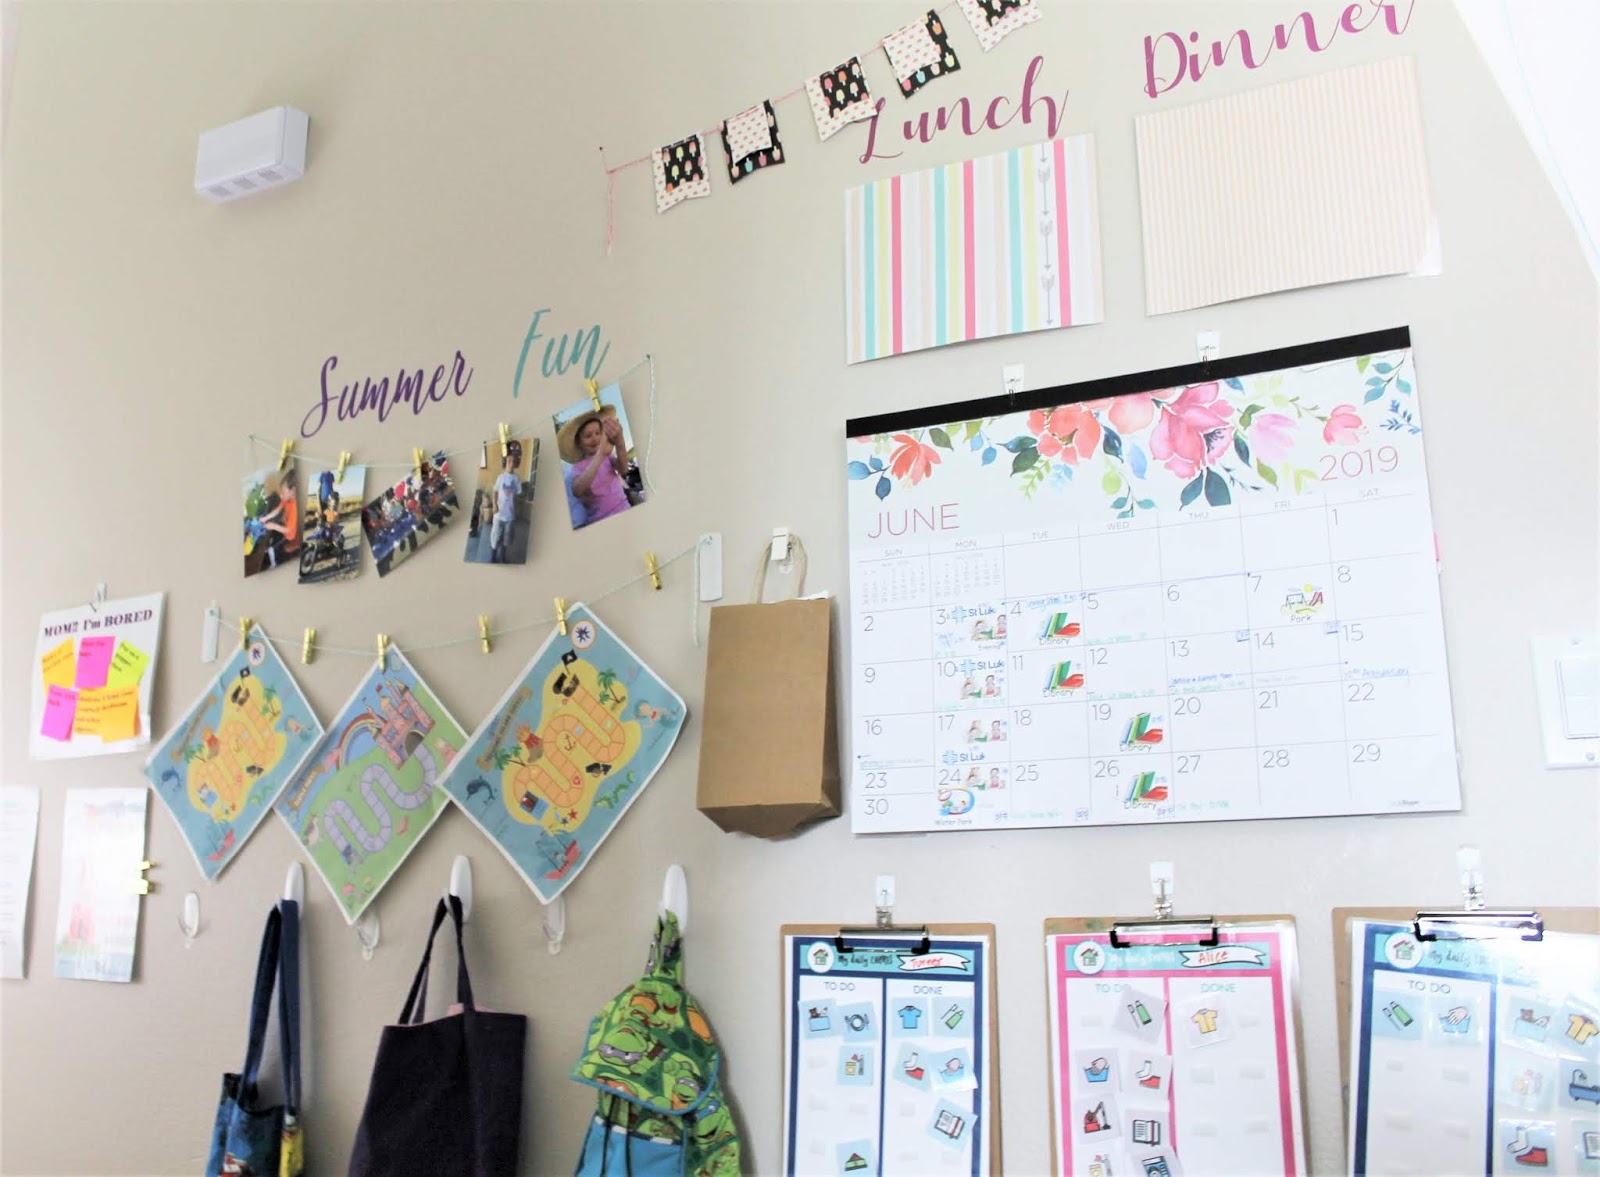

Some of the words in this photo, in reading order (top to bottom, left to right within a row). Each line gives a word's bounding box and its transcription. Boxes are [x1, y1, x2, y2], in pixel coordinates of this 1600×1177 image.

[1142, 0, 1414, 99] Dinner
[858, 55, 1069, 164] Lunch
[300, 350, 473, 438] Summer
[512, 308, 611, 399] Fun
[1319, 445, 1399, 482] 2019
[867, 502, 960, 539] JUNE
[884, 549, 903, 557] SUN
[955, 539, 978, 549] MON
[1032, 531, 1049, 540] TUE
[1106, 521, 1130, 531] WED
[1188, 512, 1209, 520] THU
[1274, 500, 1292, 509] FRI
[1361, 487, 1379, 498] SAT
[1332, 508, 1339, 526] 1
[863, 616, 875, 632] 2
[936, 608, 947, 625] 3
[1010, 601, 1022, 616] 4
[1087, 592, 1099, 611] 5
[1167, 584, 1180, 602] 6
[1251, 575, 1262, 593] 7
[1337, 565, 1352, 583] 8
[83, 619, 101, 631] I'm
[104, 609, 153, 627] BORED
[1291, 614, 1312, 623] Park
[1039, 638, 1070, 646] Library
[864, 667, 876, 684] 9
[937, 660, 958, 678] 10
[1012, 655, 1024, 671] 11
[1089, 647, 1108, 665] 12
[1170, 639, 1190, 657] 13
[1255, 632, 1276, 649] 14
[1342, 623, 1364, 641] 15
[1043, 690, 1075, 699] Library
[864, 719, 883, 736] 16
[938, 714, 955, 732] 17
[1014, 709, 1032, 726] 18
[1092, 703, 1112, 721] 19
[1174, 697, 1202, 716] 20
[1259, 690, 1279, 709] 21
[1348, 683, 1376, 702] 22
[1119, 744, 1152, 753] Library
[864, 773, 887, 789] 23
[938, 768, 961, 786] 24
[1015, 764, 1039, 782] 25
[1095, 759, 1120, 778] 26
[1177, 755, 1201, 774] 27
[1262, 749, 1291, 769] 28
[1352, 743, 1382, 763] 29
[864, 798, 889, 816] 30
[1124, 801, 1157, 810] Library
[1197, 951, 1229, 964] Alice
[825, 981, 838, 990] TO
[840, 983, 856, 992] DO
[913, 985, 943, 995] DONE
[1095, 983, 1109, 994] TO
[1201, 983, 1236, 993] DONE
[1407, 979, 1426, 992] TO
[1430, 981, 1452, 994] DO
